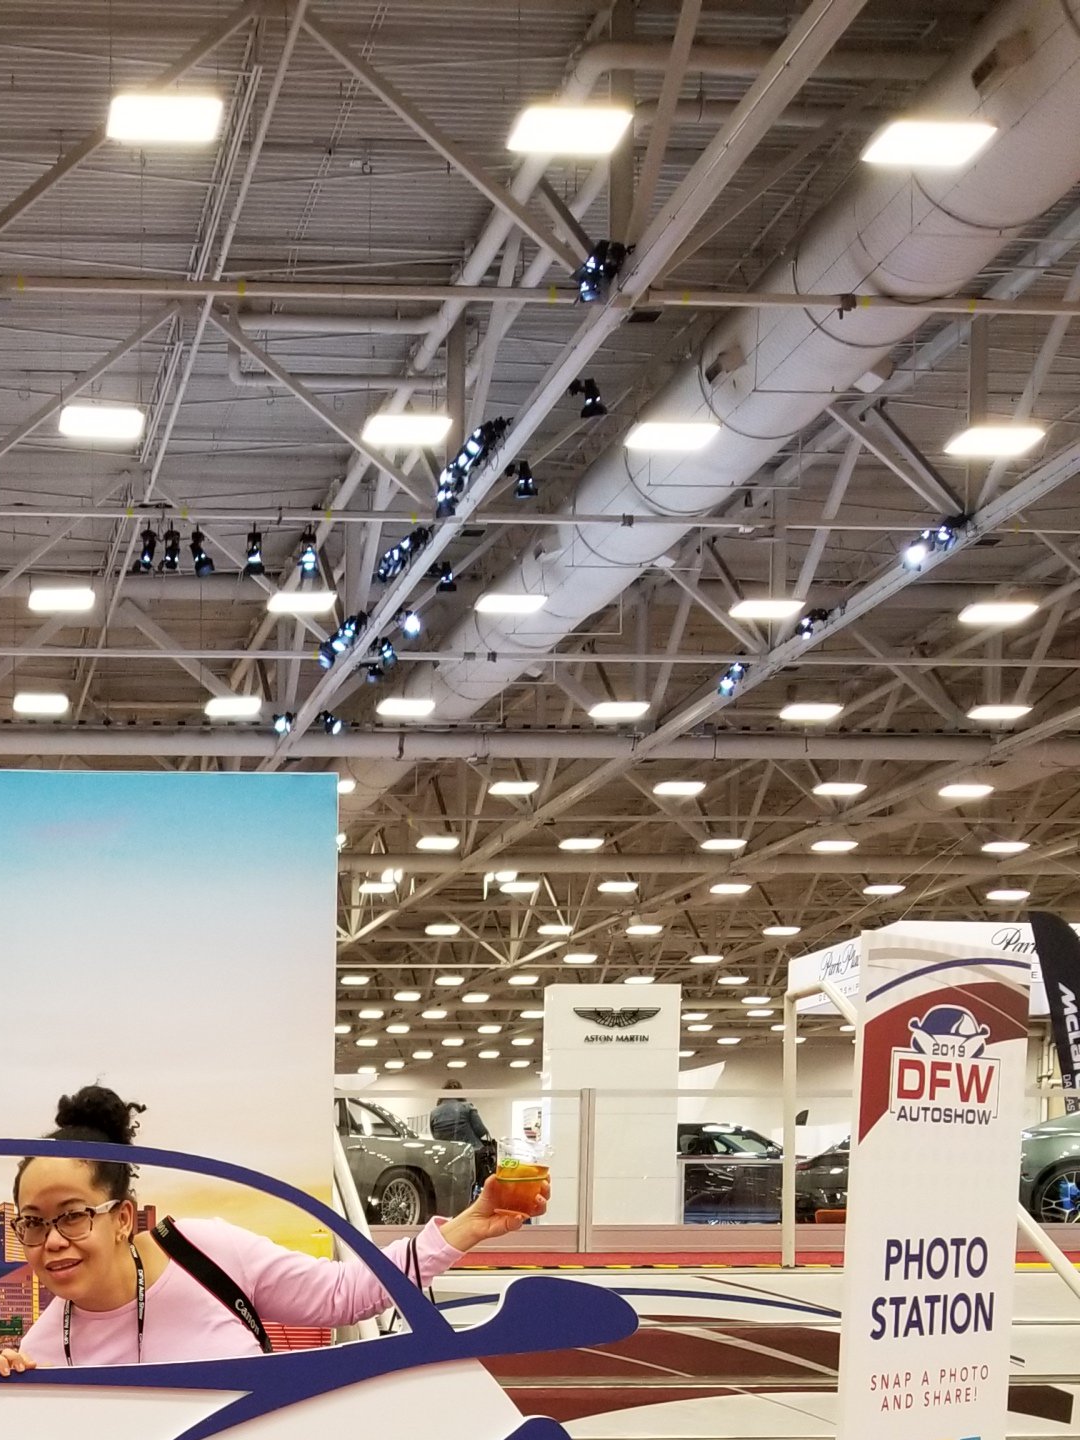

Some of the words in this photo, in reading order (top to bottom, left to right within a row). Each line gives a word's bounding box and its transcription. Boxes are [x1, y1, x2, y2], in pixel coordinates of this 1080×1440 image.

[583, 1034, 613, 1042] ASTON
[615, 1034, 649, 1042] MARTIN
[932, 1043, 966, 1058] 2019
[896, 1058, 995, 1104] DFW
[896, 1105, 993, 1126] AUTOSHOW
[885, 1236, 988, 1281] PHOTO
[234, 1298, 260, 1335] Canon
[870, 1291, 995, 1341] STATION
[870, 1372, 911, 1391] SNAP
[921, 1370, 930, 1386] A
[939, 1364, 989, 1384] PHOTO
[881, 1393, 914, 1412] AND
[924, 1387, 978, 1407] SHARE!
